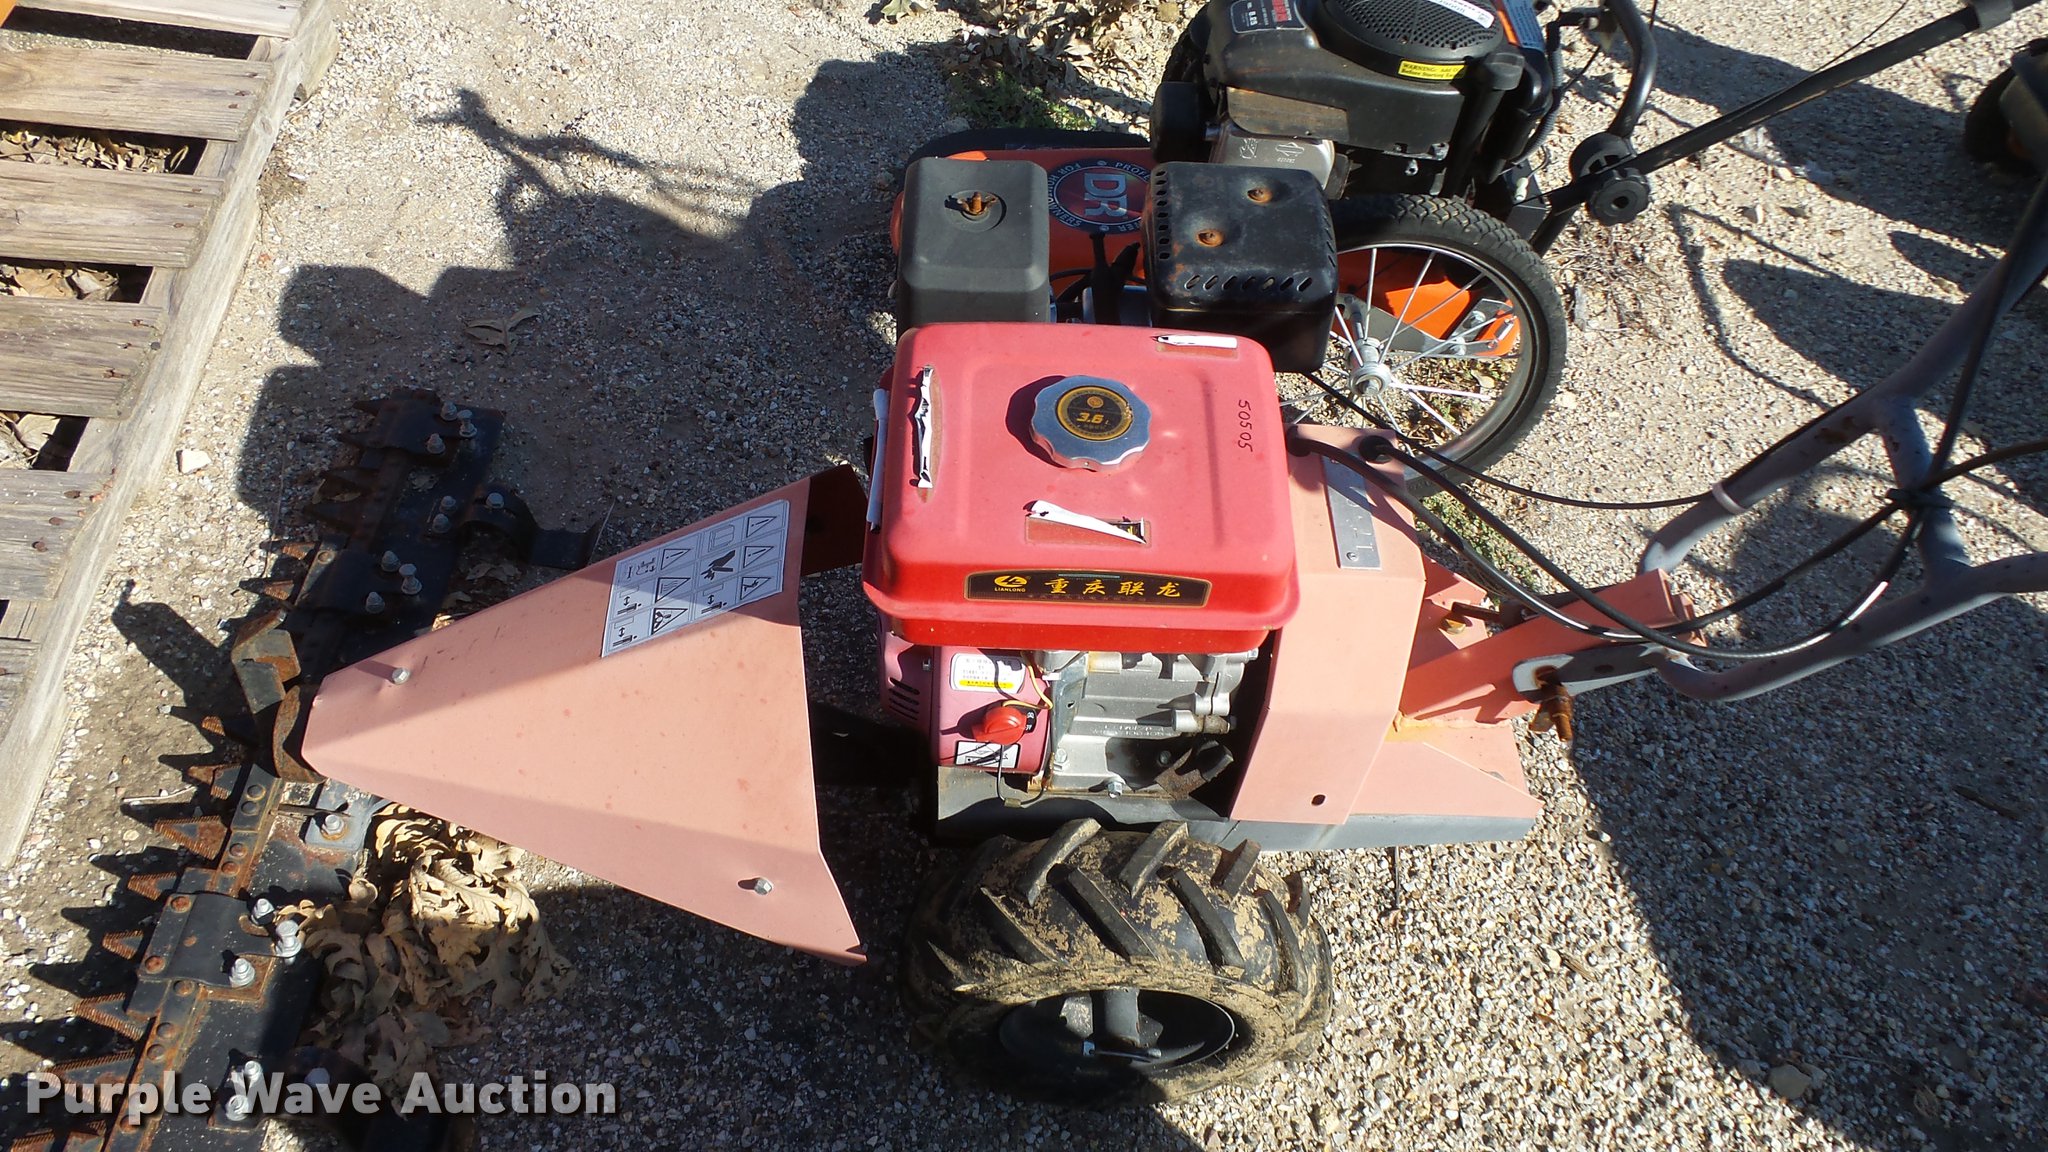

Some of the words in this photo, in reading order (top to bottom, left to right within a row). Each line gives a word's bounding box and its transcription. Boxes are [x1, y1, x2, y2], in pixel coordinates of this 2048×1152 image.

[1084, 173, 1127, 217] DR
[1076, 412, 1104, 424] 3.6
[1237, 399, 1253, 452] 50505
[1044, 578, 1180, 597] 重庆联龙
